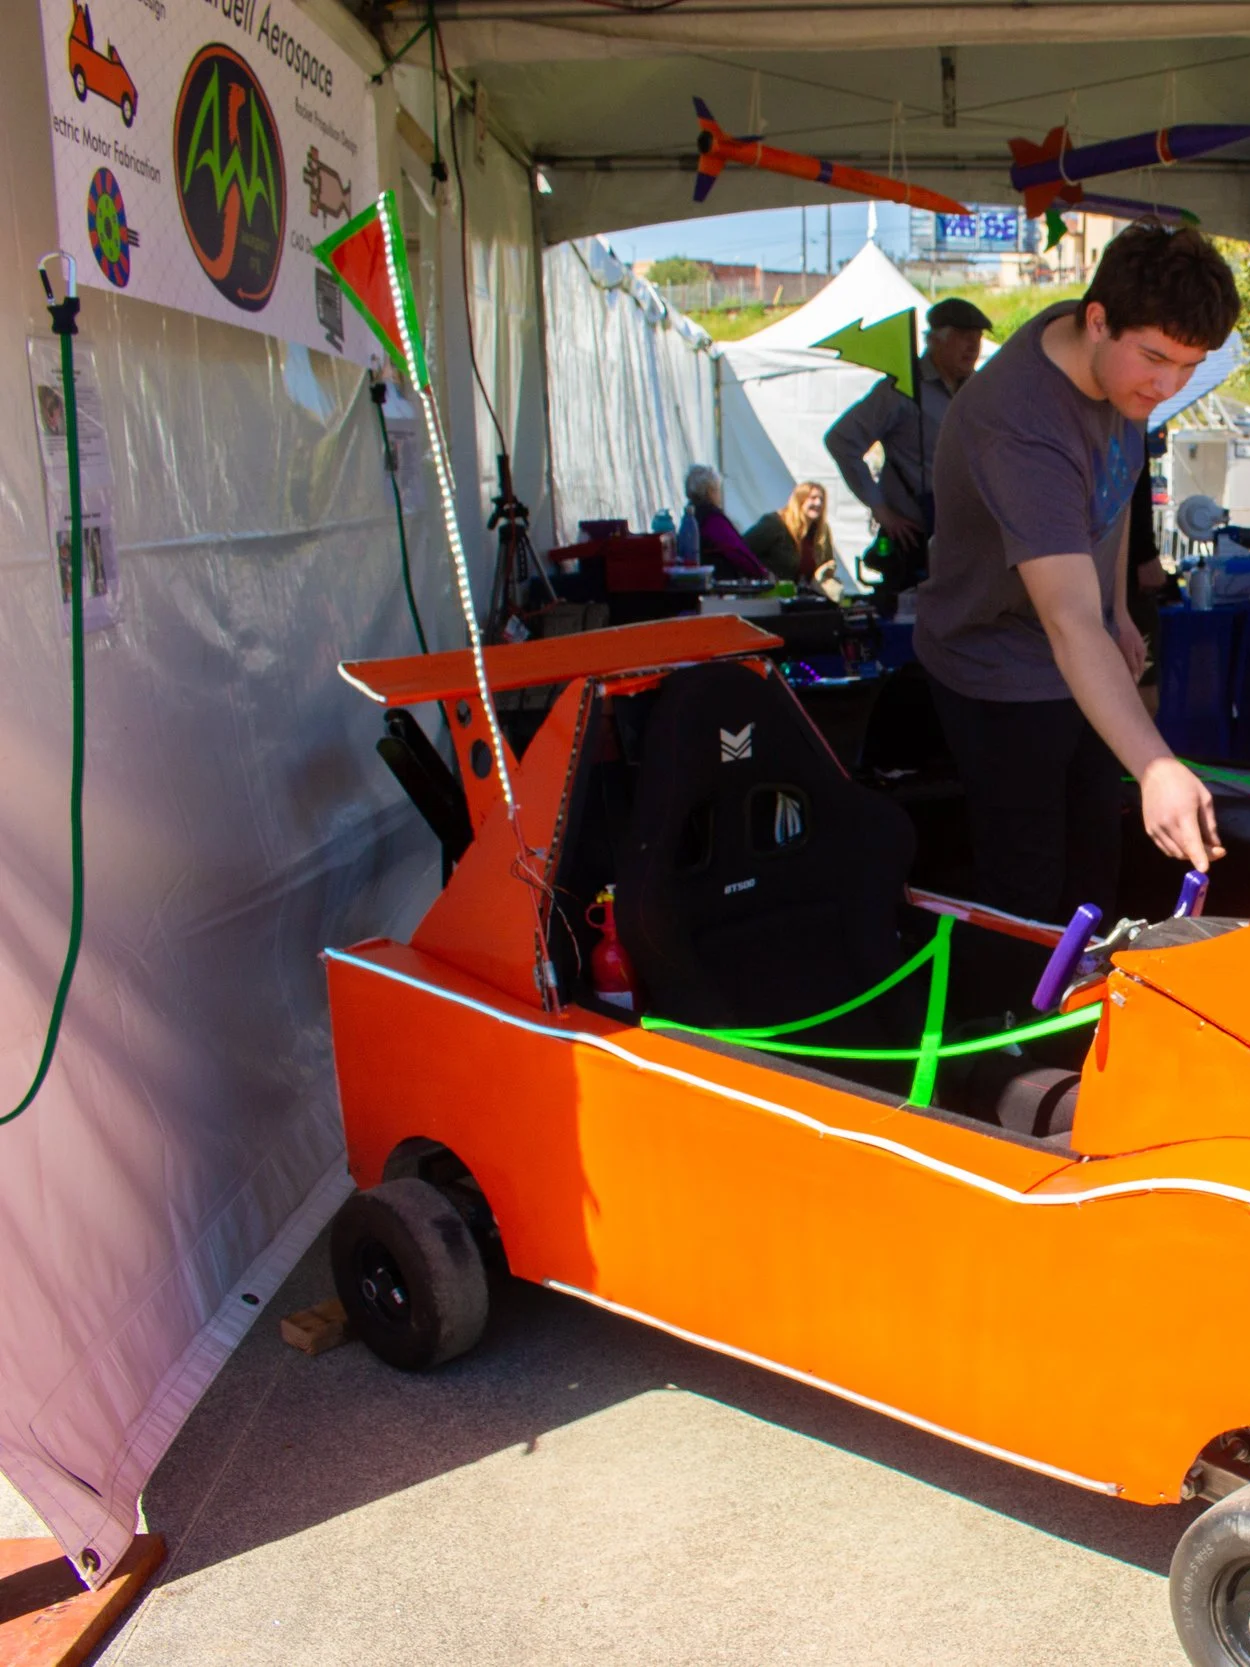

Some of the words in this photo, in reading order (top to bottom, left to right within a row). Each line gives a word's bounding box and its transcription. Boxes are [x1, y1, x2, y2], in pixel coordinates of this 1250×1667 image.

[257, 3, 333, 97] Aerospace
[53, 115, 80, 143] ectric
[82, 126, 112, 159] Motor
[113, 139, 161, 184] Fabrication
